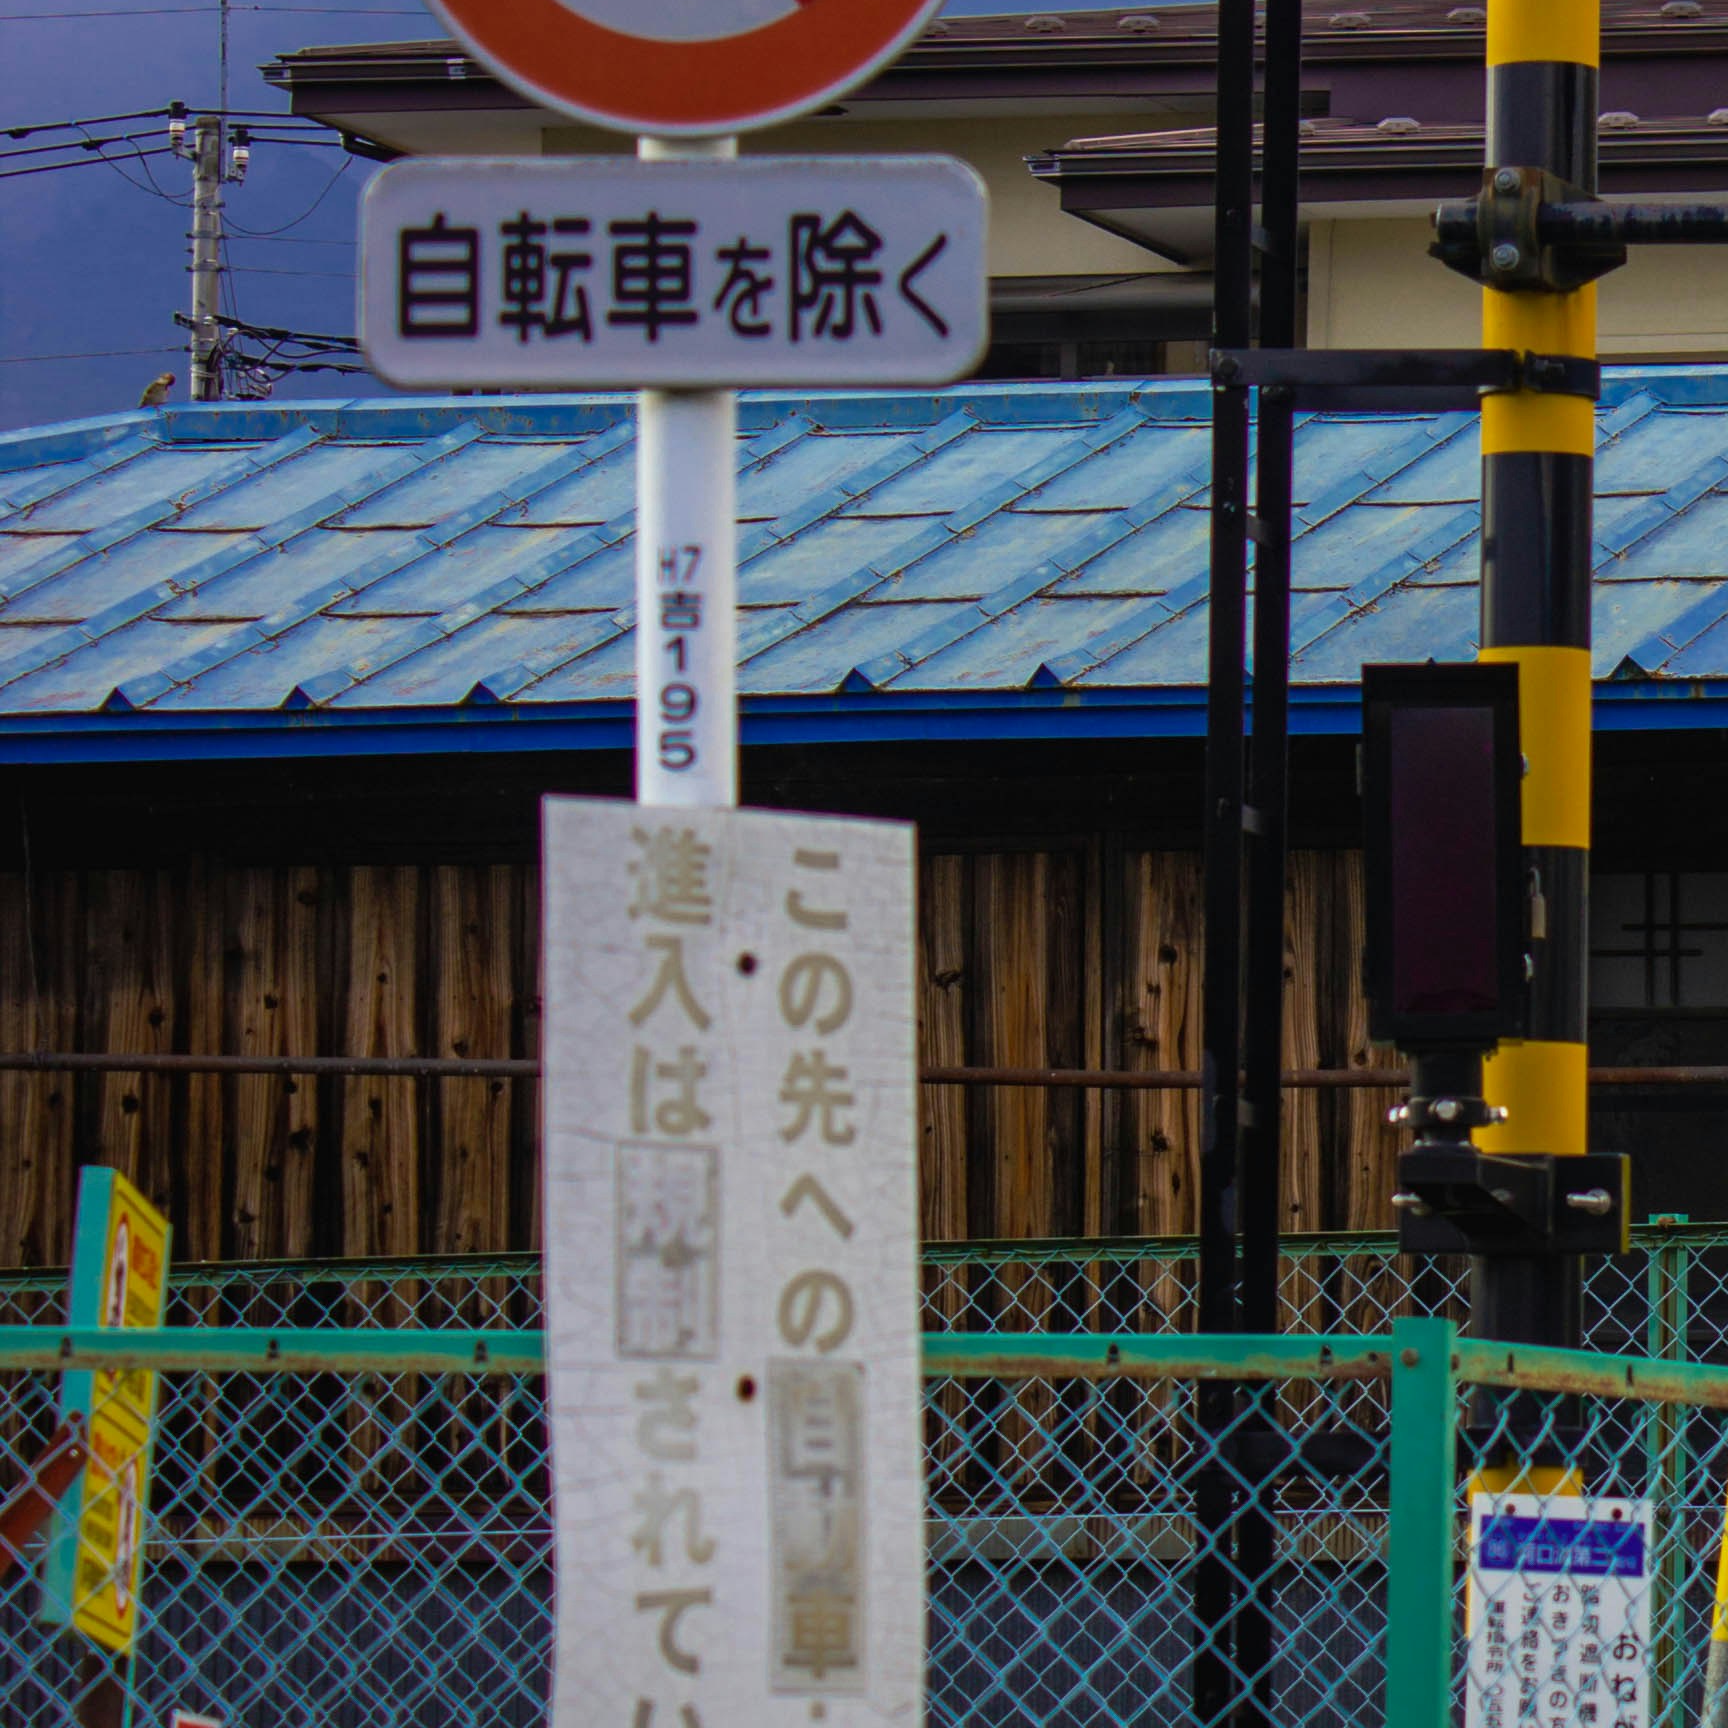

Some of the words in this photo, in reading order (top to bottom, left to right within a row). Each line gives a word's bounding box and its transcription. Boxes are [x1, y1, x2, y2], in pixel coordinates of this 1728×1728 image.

[399, 210, 949, 343] 自転車を除く
